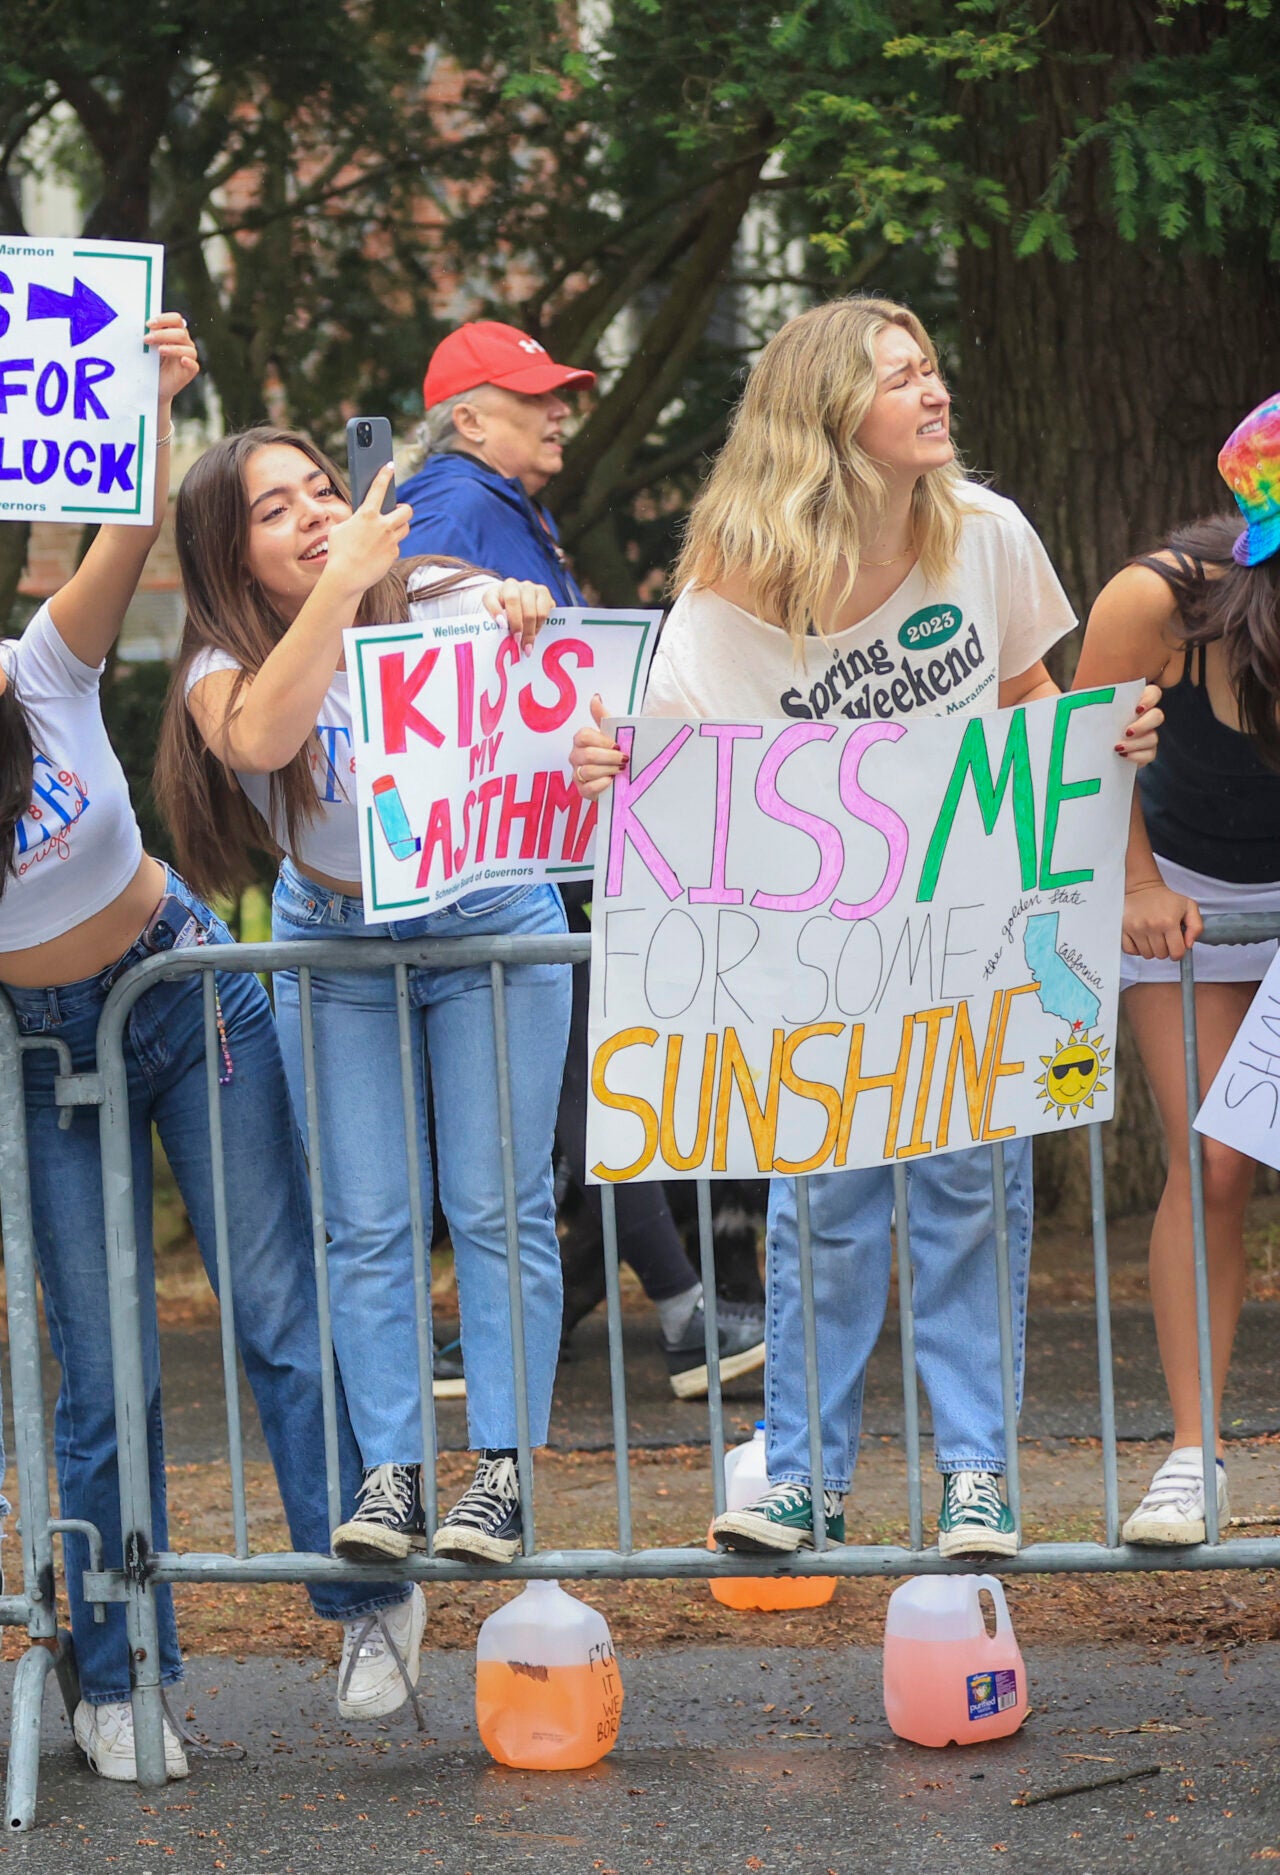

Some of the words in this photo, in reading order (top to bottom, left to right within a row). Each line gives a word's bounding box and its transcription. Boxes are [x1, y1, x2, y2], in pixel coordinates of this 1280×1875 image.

[433, 623, 480, 638] Wellesley
[907, 611, 956, 644] 2023
[379, 634, 594, 755] KISS
[780, 639, 896, 719] Spring
[469, 731, 504, 783] MY
[604, 721, 908, 920] KISS
[916, 687, 1116, 903] ME
[461, 873, 474, 889] Board
[475, 870, 483, 882] of
[484, 867, 534, 879] Governors
[982, 946, 1003, 981] the
[1002, 894, 1042, 944] golden
[603, 908, 760, 1025] FOR
[782, 903, 985, 1025] SOME
[590, 981, 1041, 1182] SUNSHINE
[602, 1673, 614, 1695] IT
[603, 1694, 621, 1717] WE
[970, 1696, 996, 1714] purified
